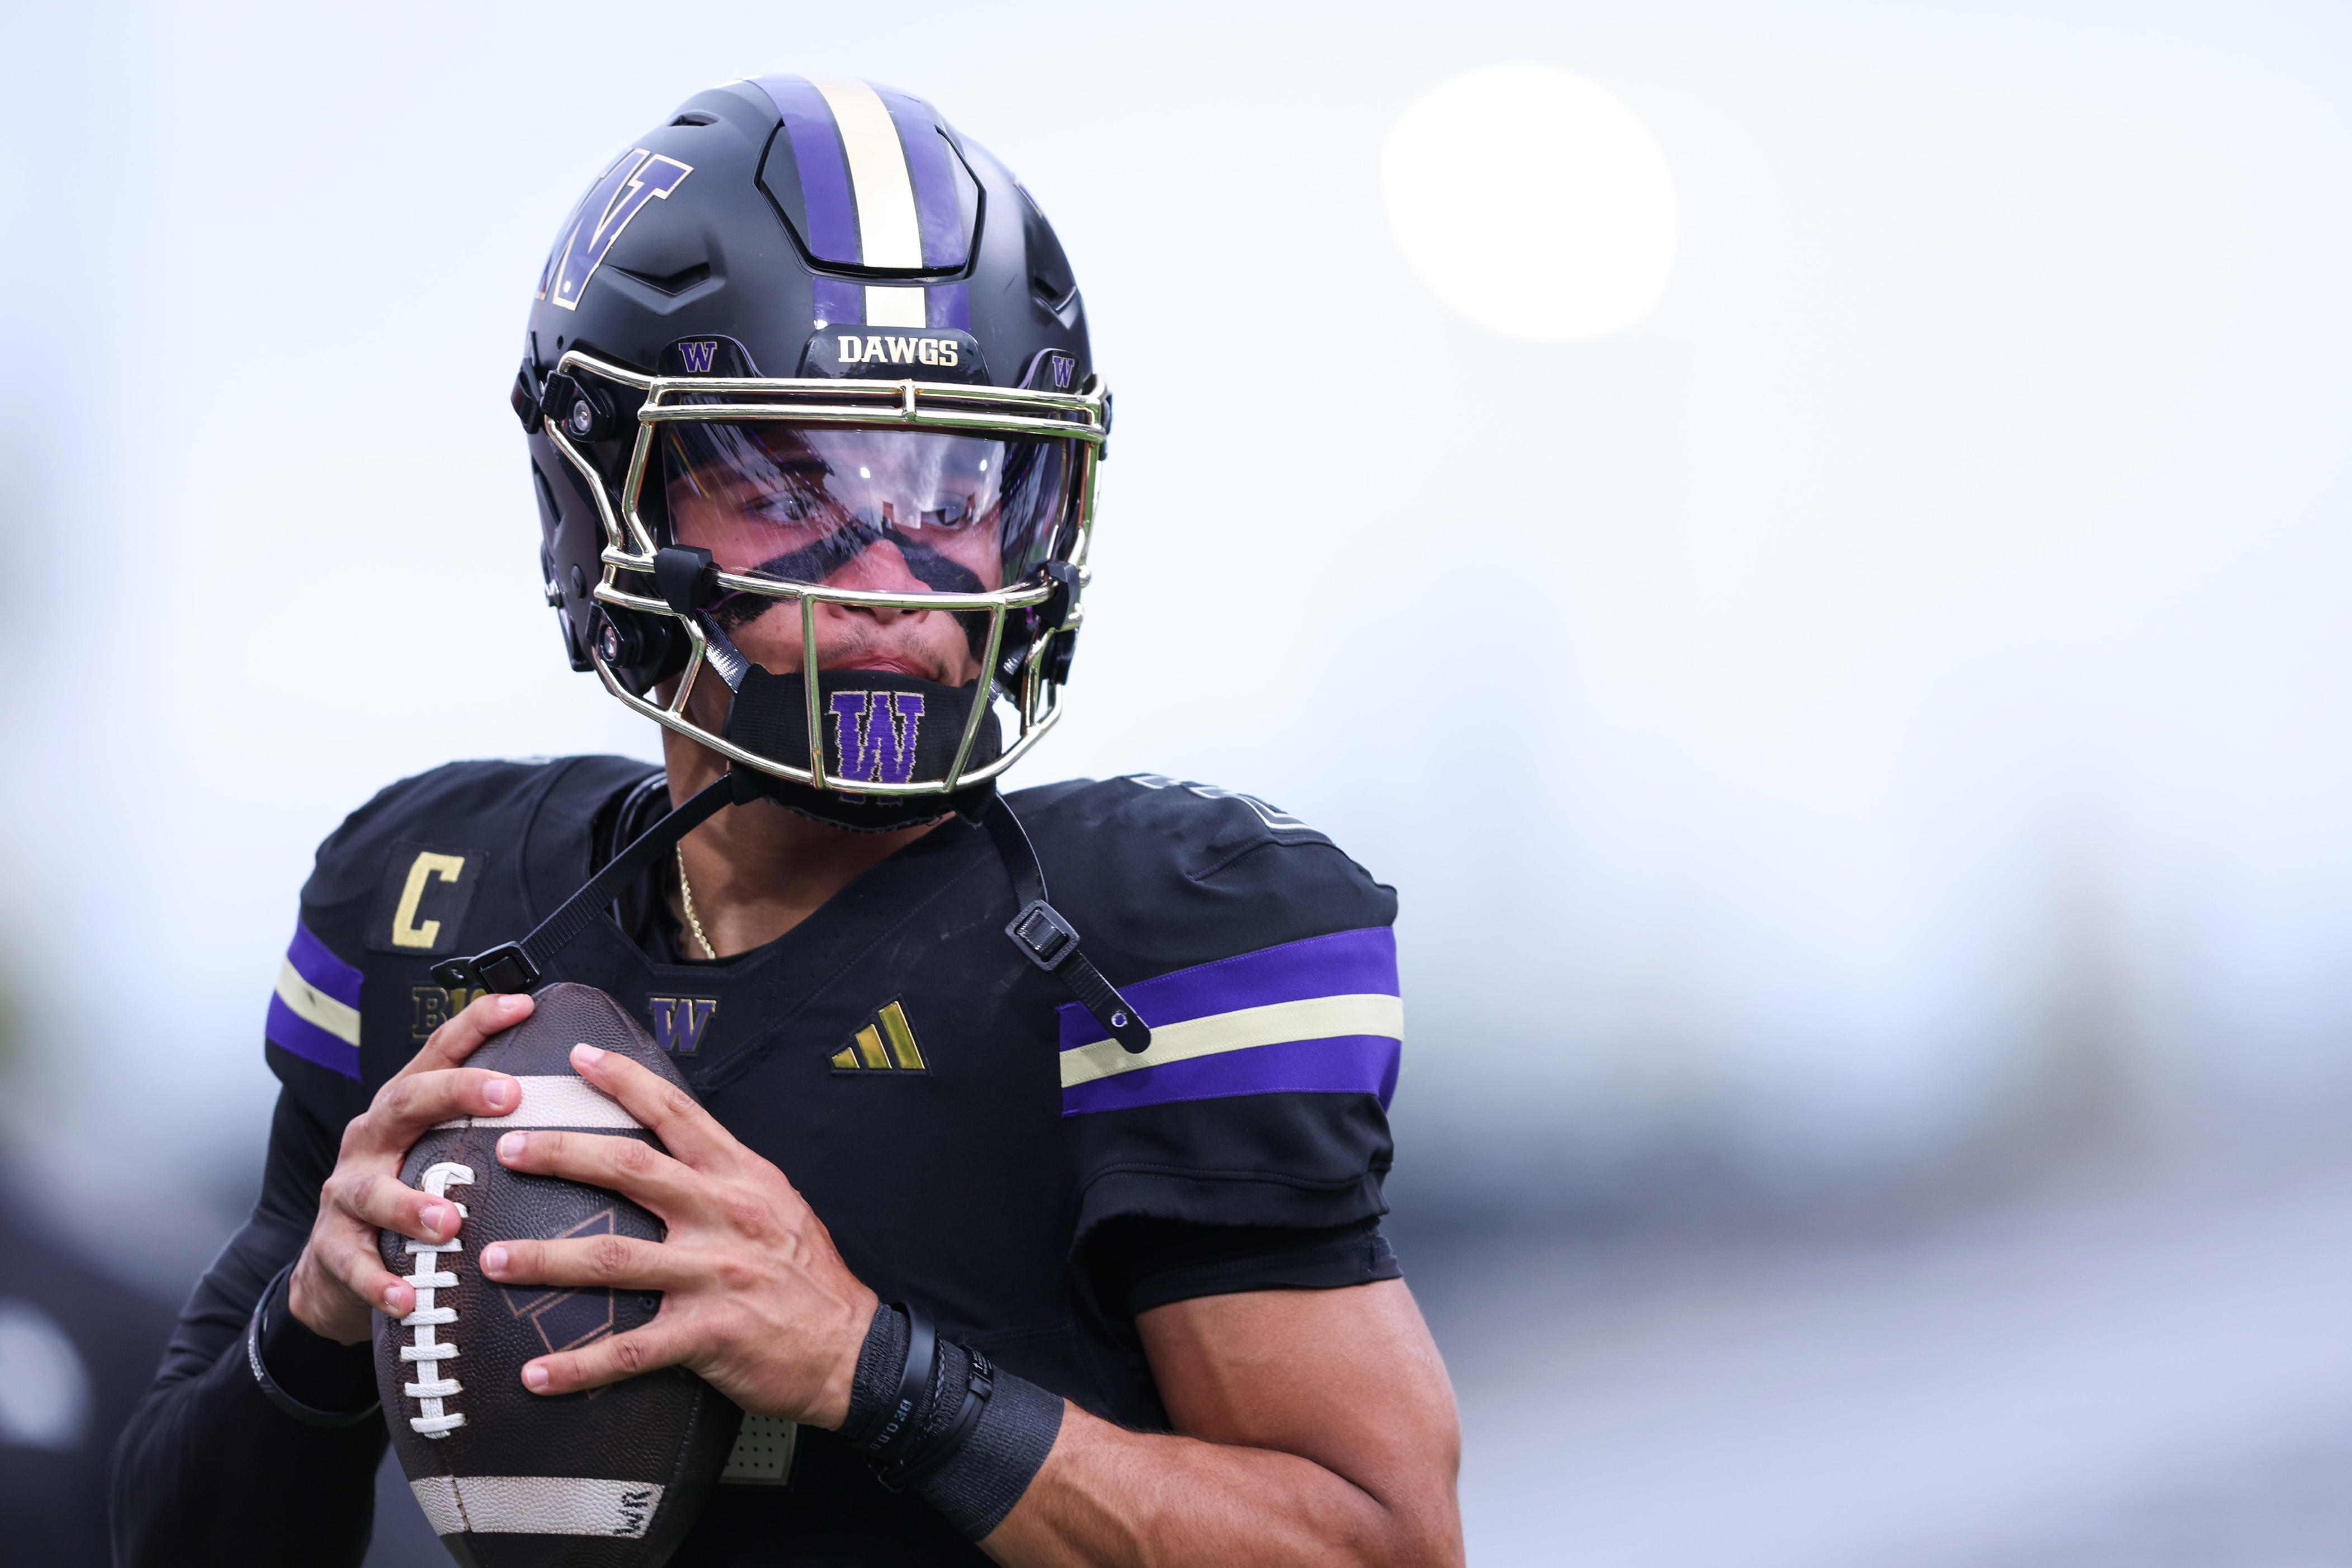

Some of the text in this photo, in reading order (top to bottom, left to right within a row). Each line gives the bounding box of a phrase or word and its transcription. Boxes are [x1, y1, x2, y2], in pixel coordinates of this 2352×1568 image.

[678, 342, 717, 373] W
[838, 336, 958, 367] DAWGS
[1052, 355, 1075, 388] W
[826, 691, 925, 806] W
[393, 851, 465, 949] C
[649, 997, 716, 1052] W
